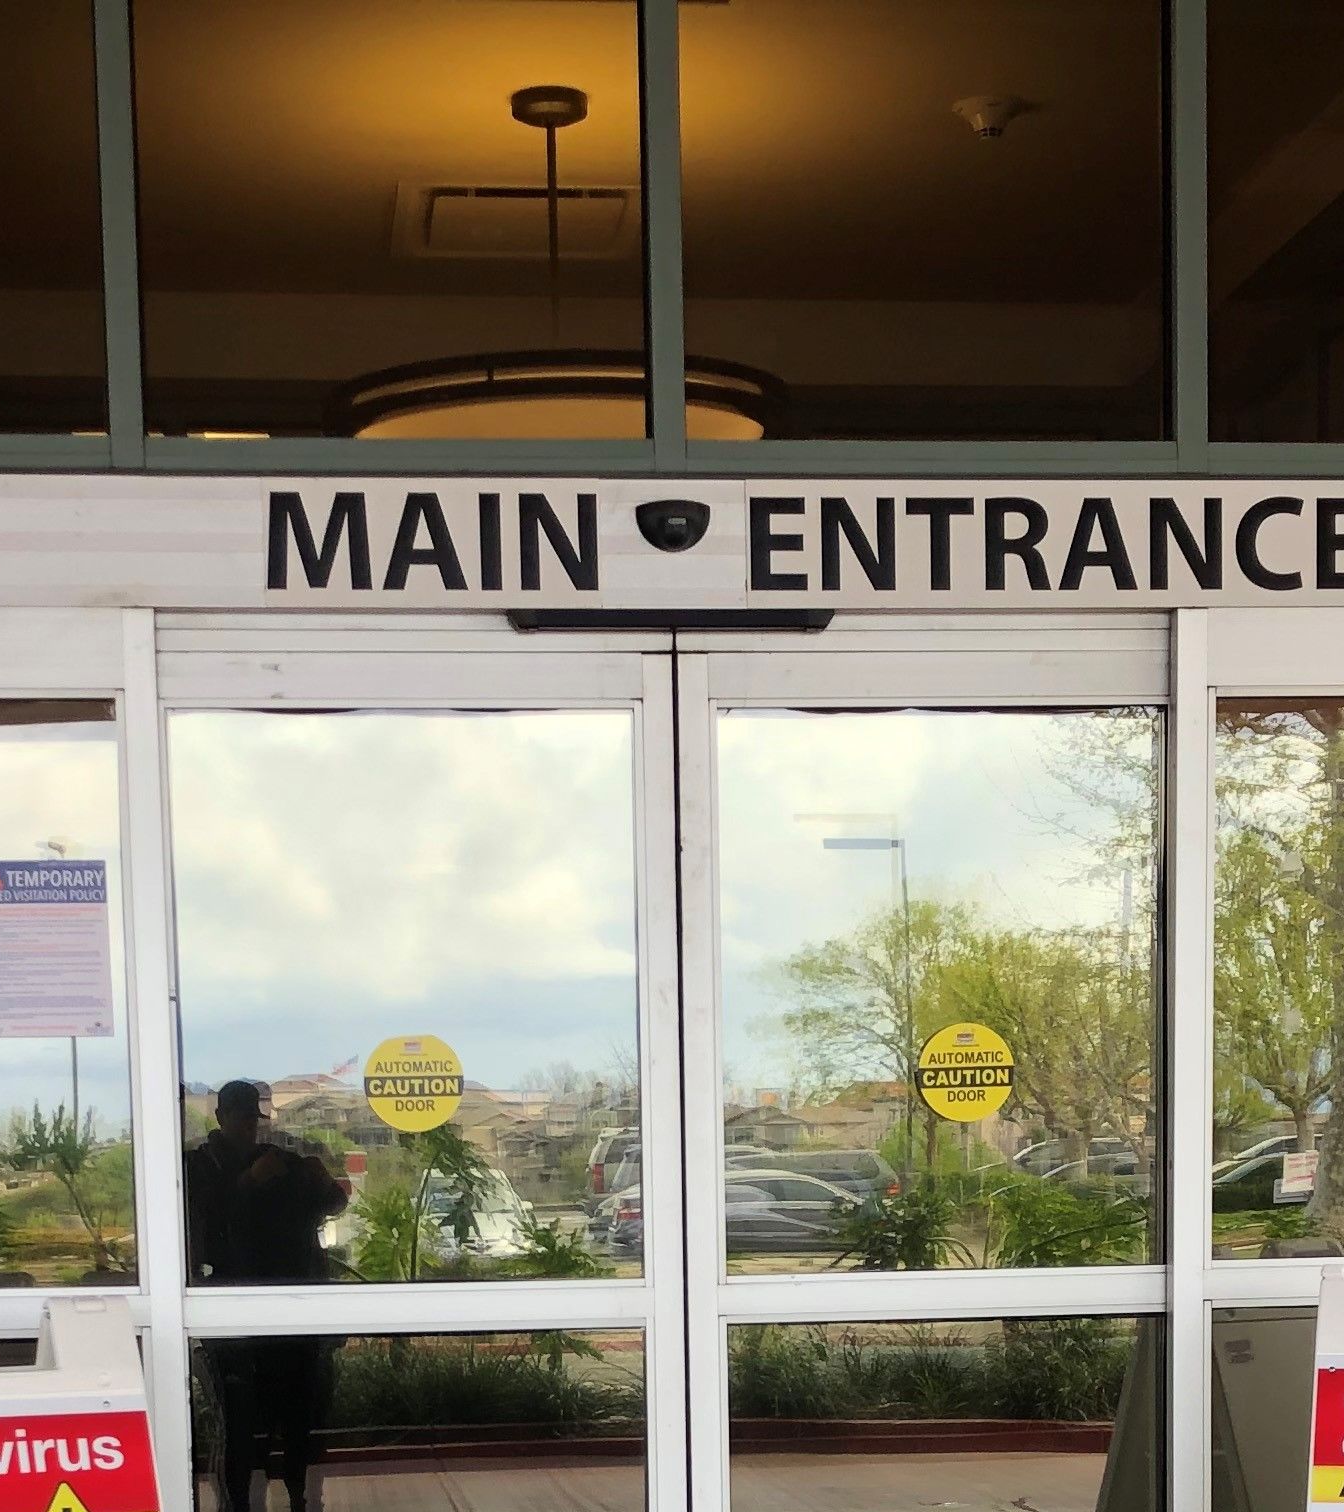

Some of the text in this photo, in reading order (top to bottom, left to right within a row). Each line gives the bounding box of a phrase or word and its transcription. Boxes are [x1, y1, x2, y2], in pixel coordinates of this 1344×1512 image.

[267, 491, 599, 591] MAIN
[6, 870, 104, 887] TEMPORARY
[70, 889, 104, 901] POLICY
[928, 1051, 1004, 1065] AUTOMATIC
[375, 1060, 453, 1074] AUTOMATIC
[922, 1068, 1009, 1086] CAUTION
[368, 1078, 459, 1095] CAUTION
[947, 1090, 986, 1102] DOOR
[395, 1100, 436, 1112] DOOR
